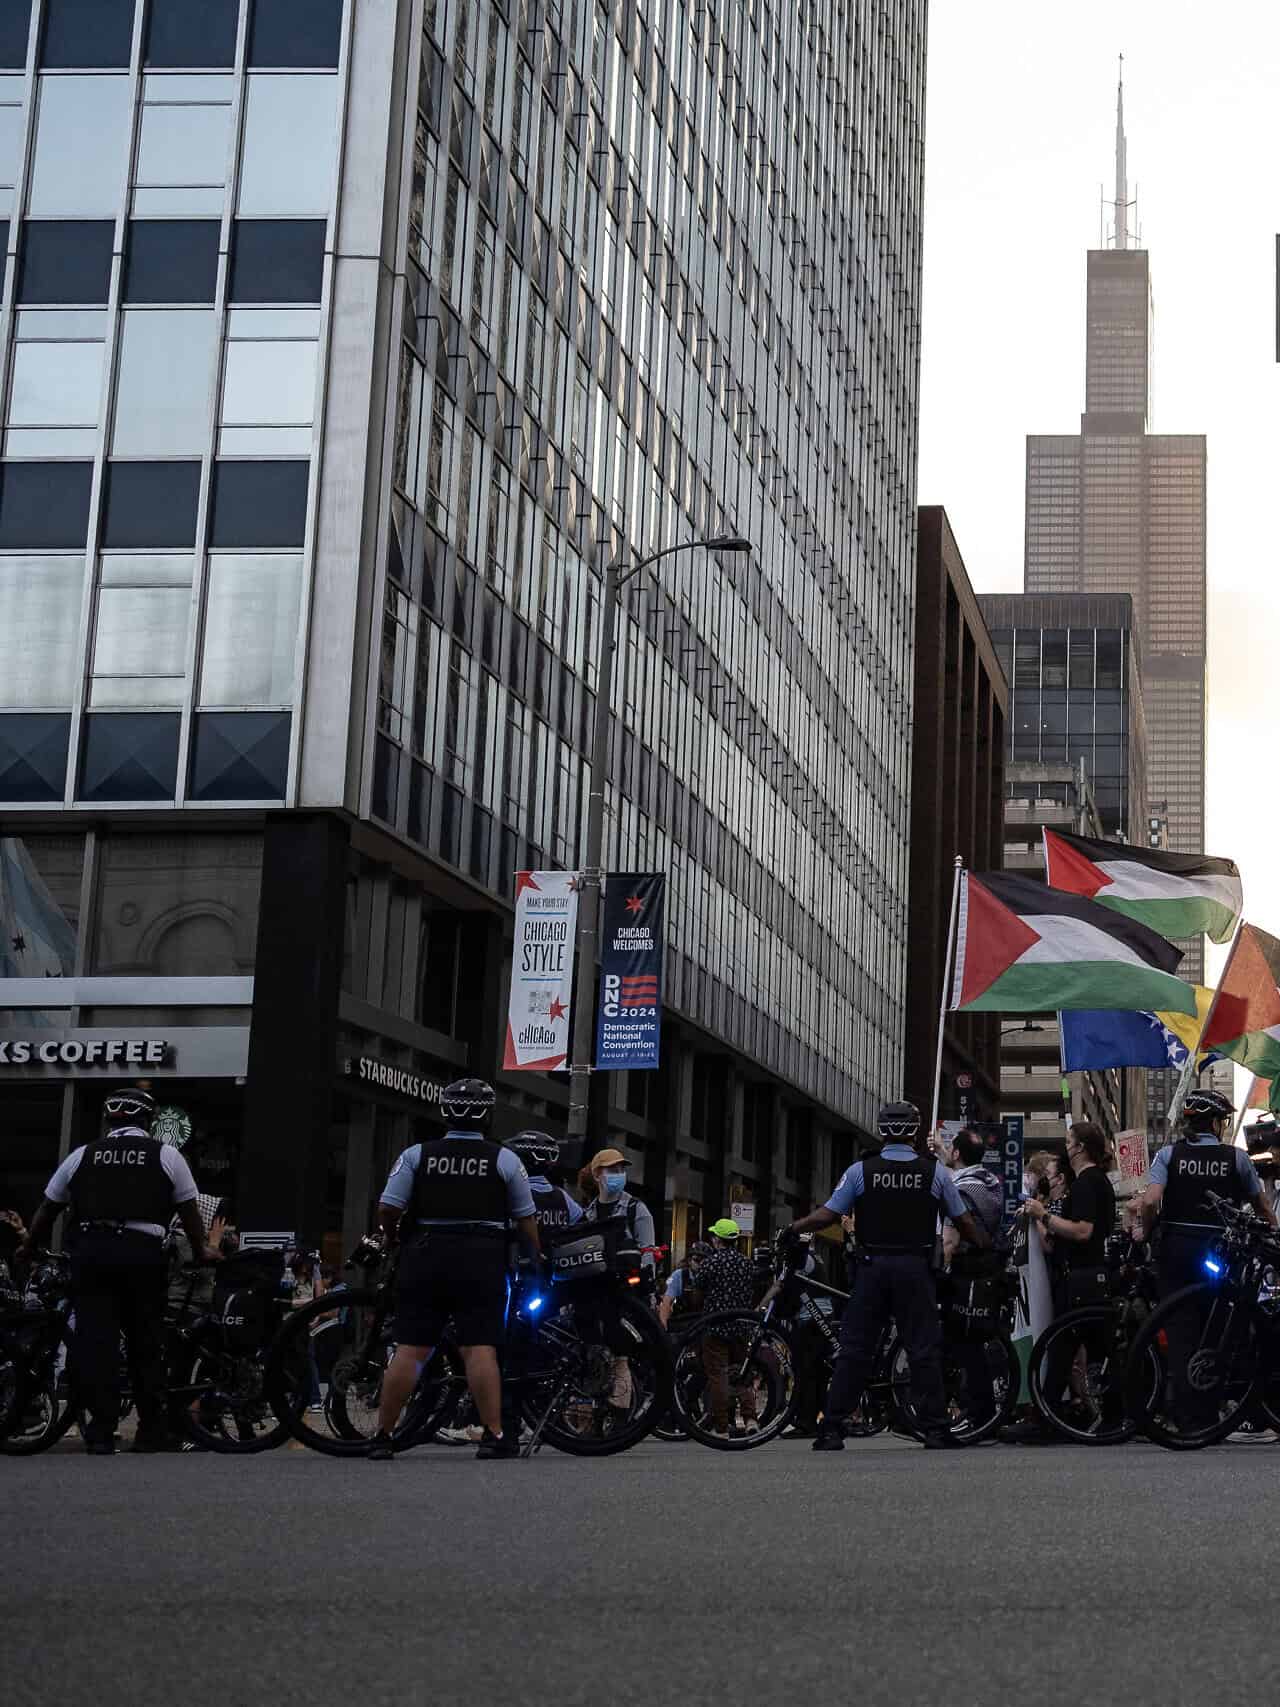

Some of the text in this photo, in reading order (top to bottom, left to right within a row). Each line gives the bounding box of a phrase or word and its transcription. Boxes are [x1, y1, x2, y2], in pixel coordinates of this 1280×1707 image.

[524, 921, 567, 941] CHICAGO
[617, 927, 650, 939] CHICAGO
[612, 939, 654, 951] WELCOMES
[521, 943, 565, 972] STYLE
[603, 974, 620, 1017] DNC
[620, 1007, 656, 1017] 2024
[603, 1021, 656, 1031] Democratic
[603, 1032, 640, 1040] National
[39, 1040, 164, 1063] COFFEE
[602, 1040, 655, 1049] Convention
[360, 1056, 419, 1096] STARBUCKS
[420, 1080, 445, 1104] COFF
[93, 1150, 147, 1165] POLICE
[426, 1157, 488, 1176] POLICE
[1178, 1159, 1228, 1177] POLICE
[872, 1173, 923, 1188] POLICE
